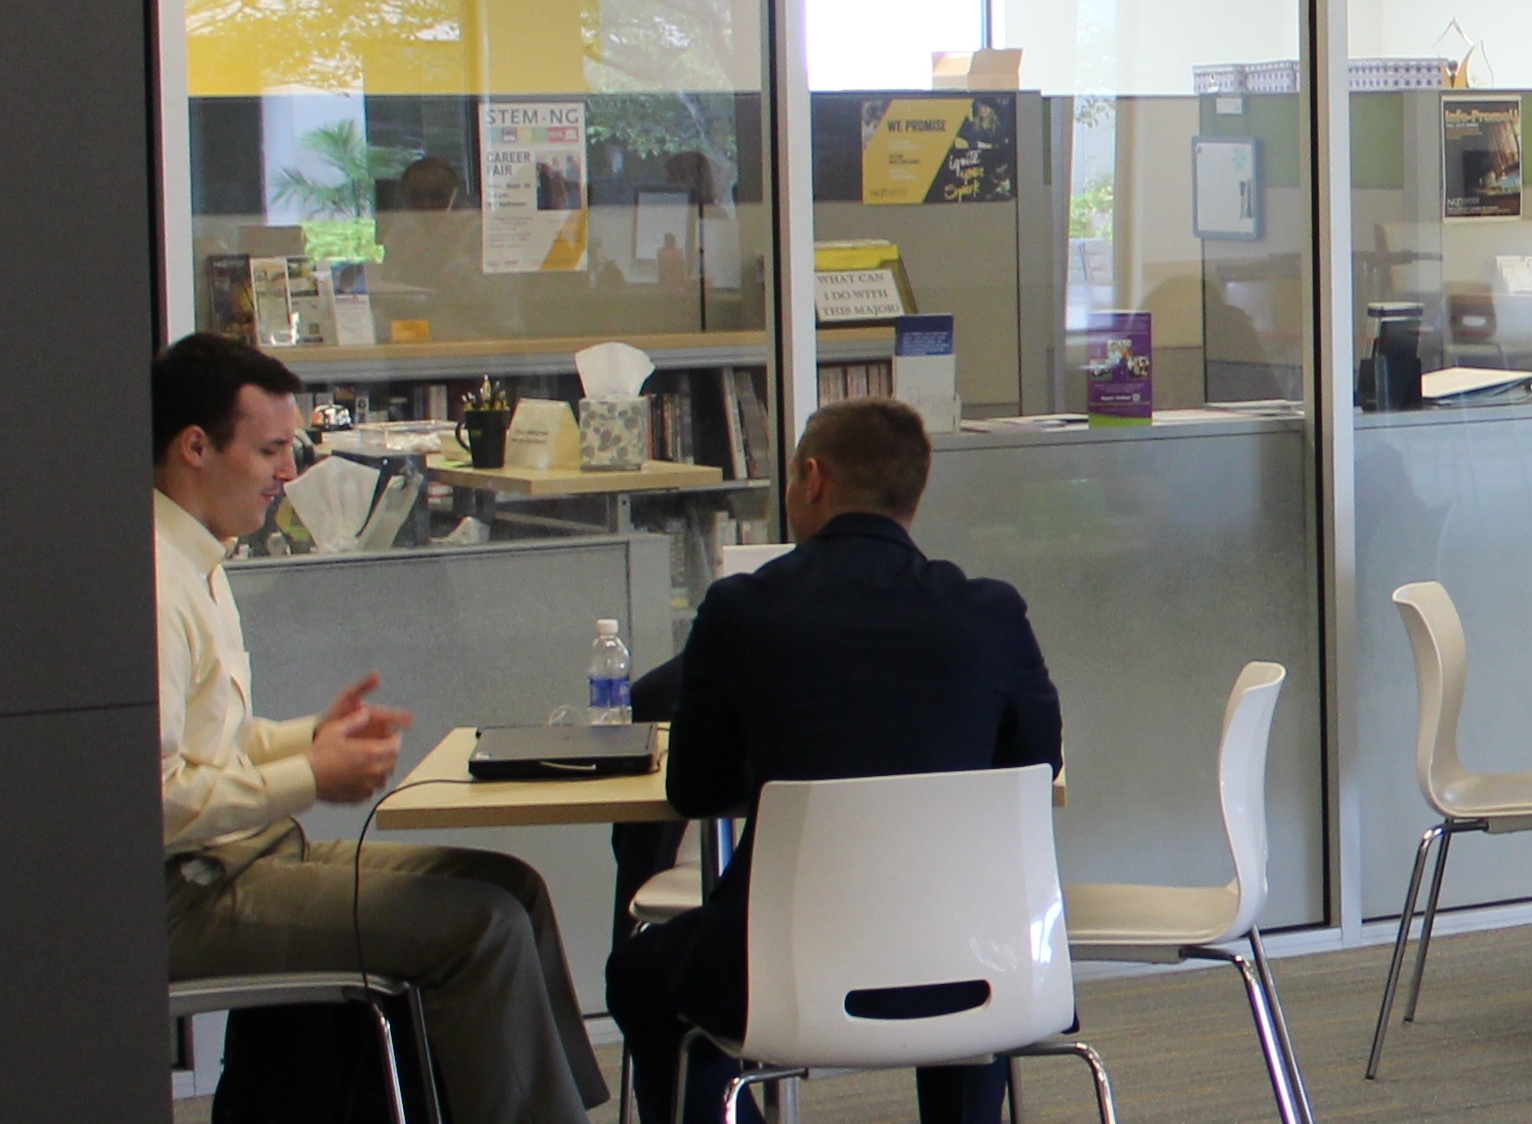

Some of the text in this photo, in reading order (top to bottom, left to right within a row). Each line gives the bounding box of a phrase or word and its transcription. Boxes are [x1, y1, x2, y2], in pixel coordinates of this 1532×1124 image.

[887, 119, 947, 133] WE PROMISE
[486, 151, 531, 163] CAREER
[486, 164, 513, 176] FAIR
[816, 272, 885, 285] WHAT CAN
[831, 290, 851, 301] DO
[852, 288, 889, 300] WITH
[821, 307, 852, 317] THIS
